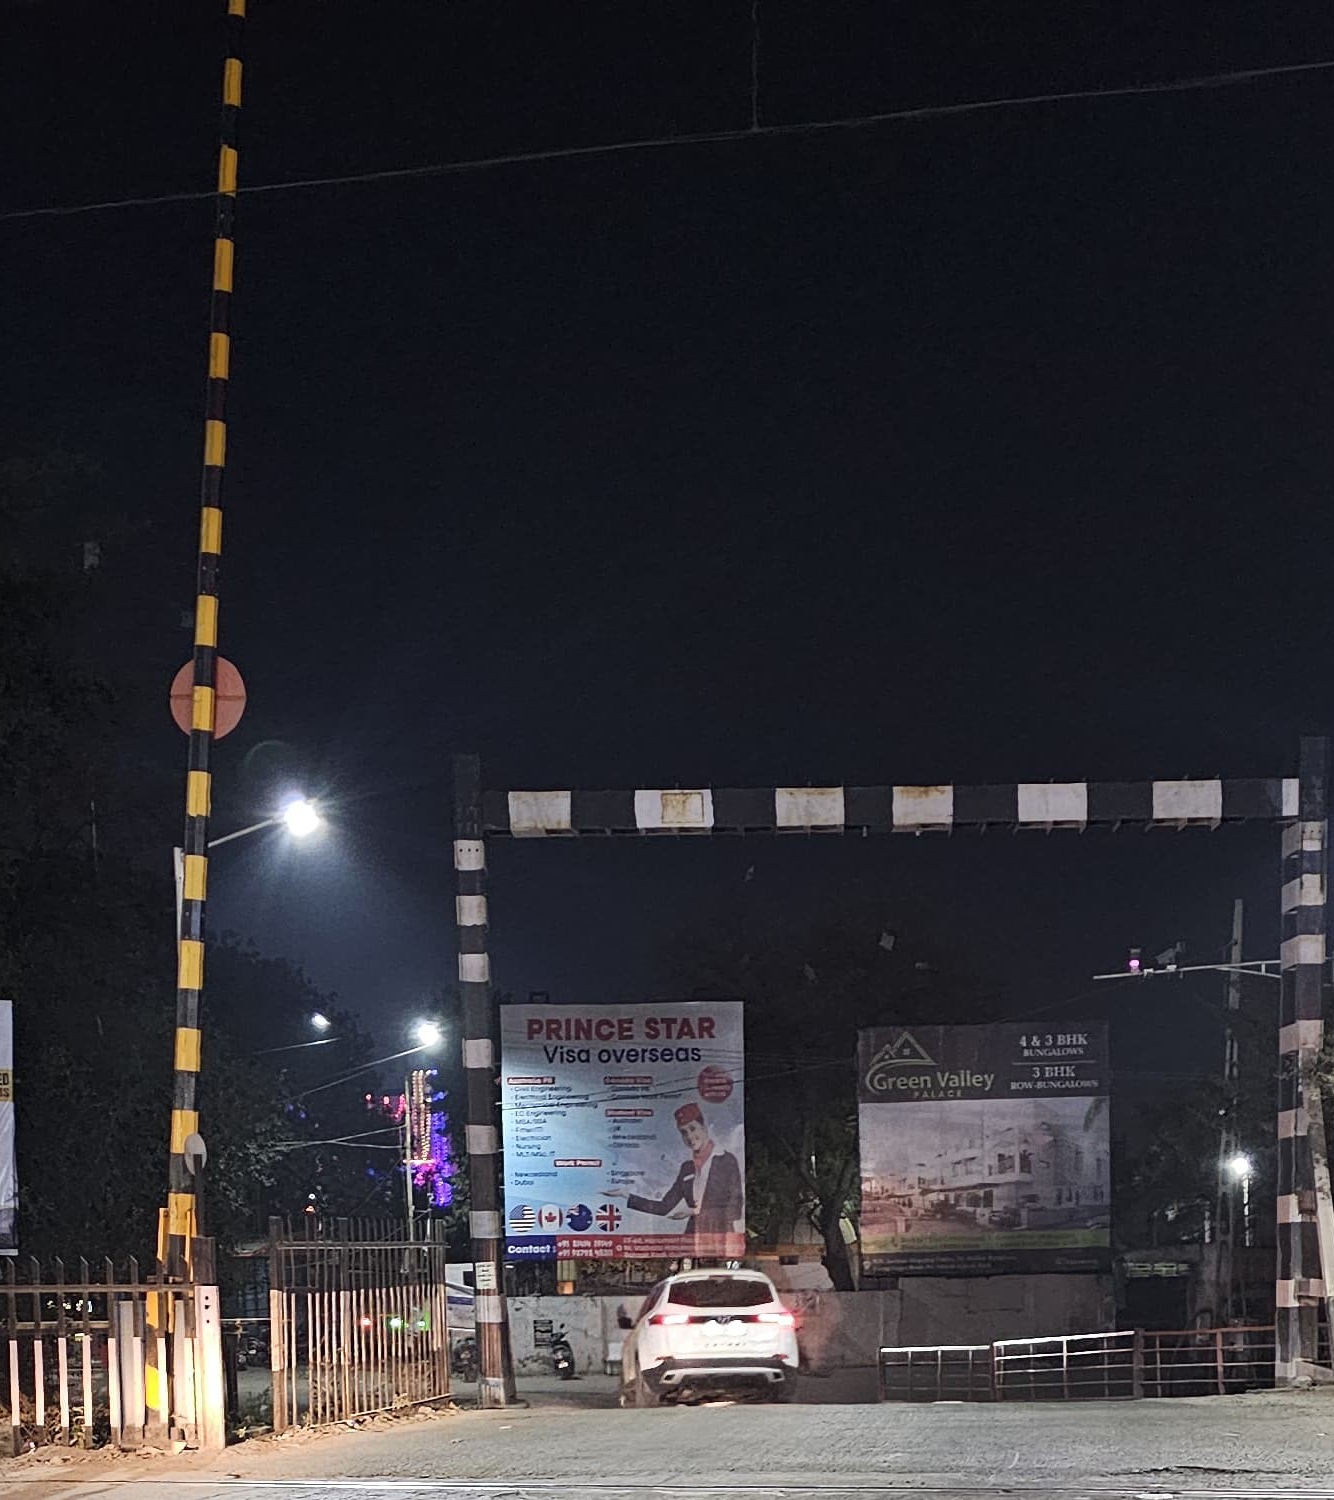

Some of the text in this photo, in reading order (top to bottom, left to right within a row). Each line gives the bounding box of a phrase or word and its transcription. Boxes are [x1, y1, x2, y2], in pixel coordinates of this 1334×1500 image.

[526, 1016, 716, 1042] PRINCE STAR
[1019, 1033, 1088, 1047] 4 & 3 BHK
[543, 1044, 702, 1065] Visa overseas
[1023, 1047, 1084, 1057] BUNGALOWS
[1032, 1065, 1076, 1078] 3 BHK
[873, 1070, 995, 1091] Green Valley
[914, 1090, 962, 1099] PALACE
[507, 1244, 551, 1255] Contact
